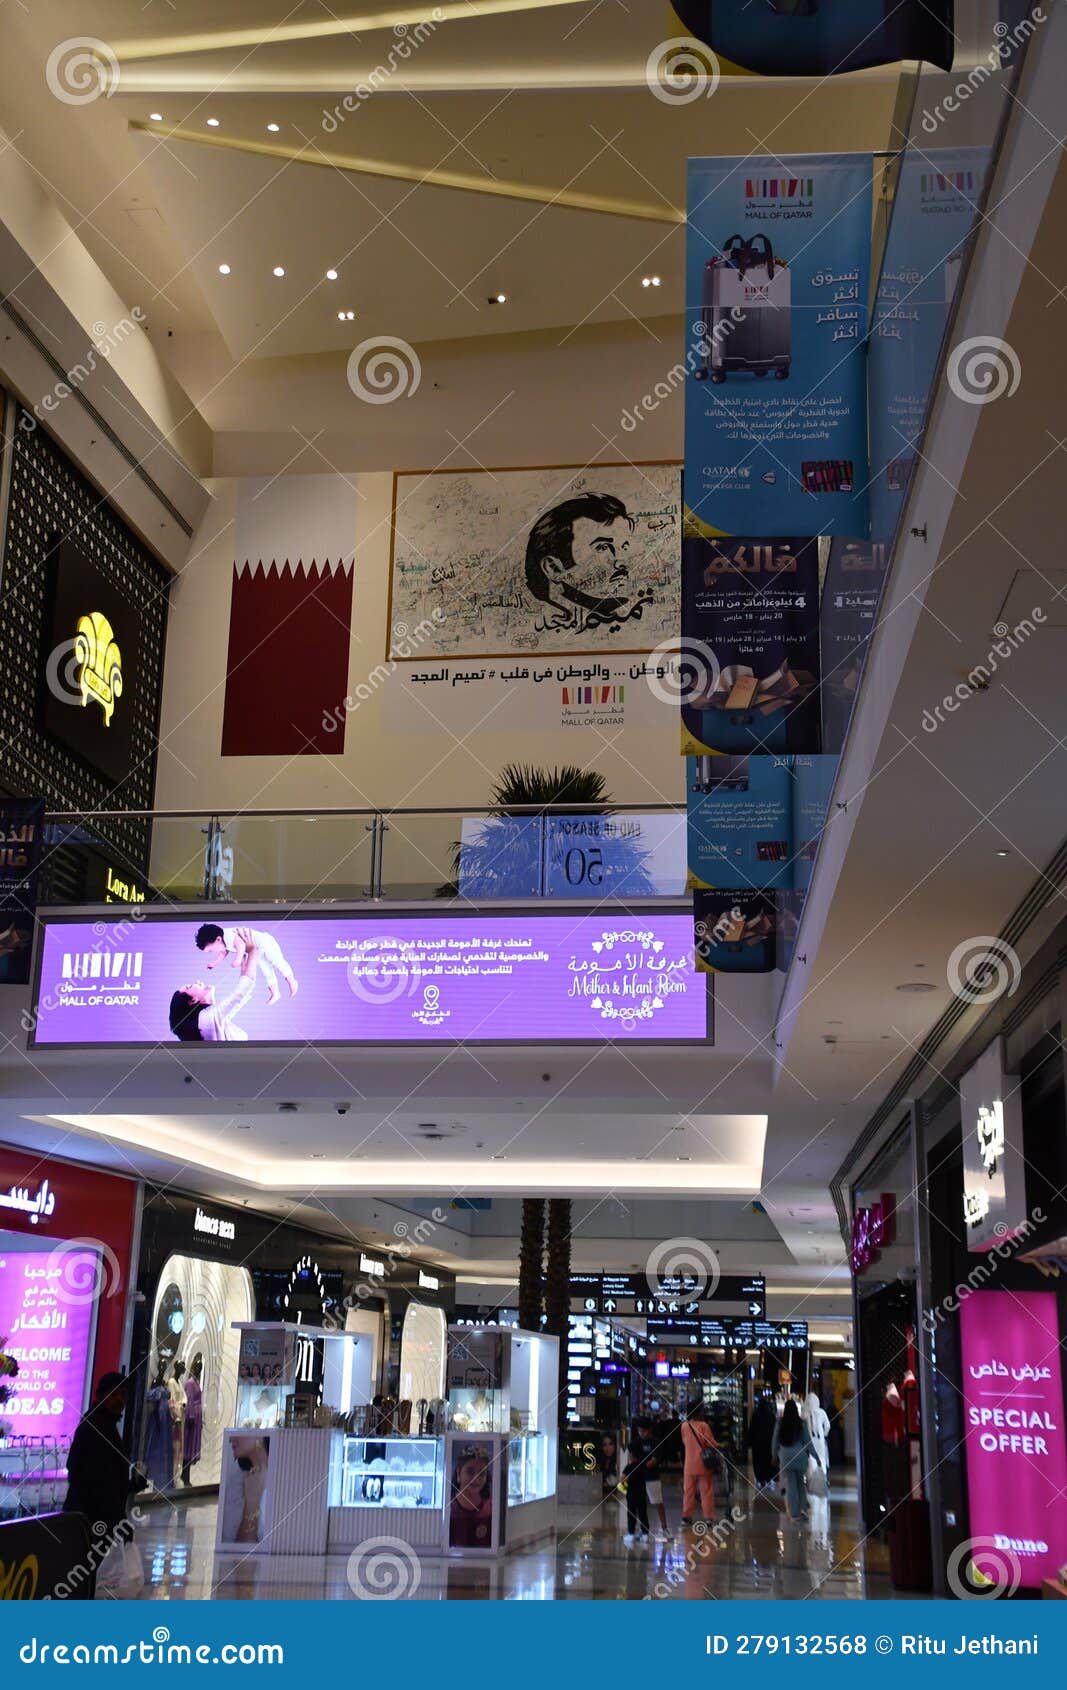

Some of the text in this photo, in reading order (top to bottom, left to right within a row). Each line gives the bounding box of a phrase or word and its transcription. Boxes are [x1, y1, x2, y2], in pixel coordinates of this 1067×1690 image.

[783, 211, 813, 220] QATAR
[794, 596, 807, 609] 4
[411, 668, 449, 685] المجد
[452, 669, 486, 687] تميم
[500, 666, 530, 682] قلب
[556, 664, 611, 681] والوطن
[561, 717, 624, 727] MALL OF QATAR
[107, 867, 128, 901] Lora
[59, 995, 139, 1006] MALL OF QATAR
[0, 1179, 56, 1224] دايس
[25, 1264, 62, 1280] مرحبا
[10, 1309, 67, 1333] الأفكار
[33, 1369, 50, 1379] THE
[969, 1360, 1052, 1381] عرض خاص
[43, 1382, 57, 1391] OF
[968, 1406, 1057, 1431] SPECIAL
[979, 1432, 1049, 1455] OFFER
